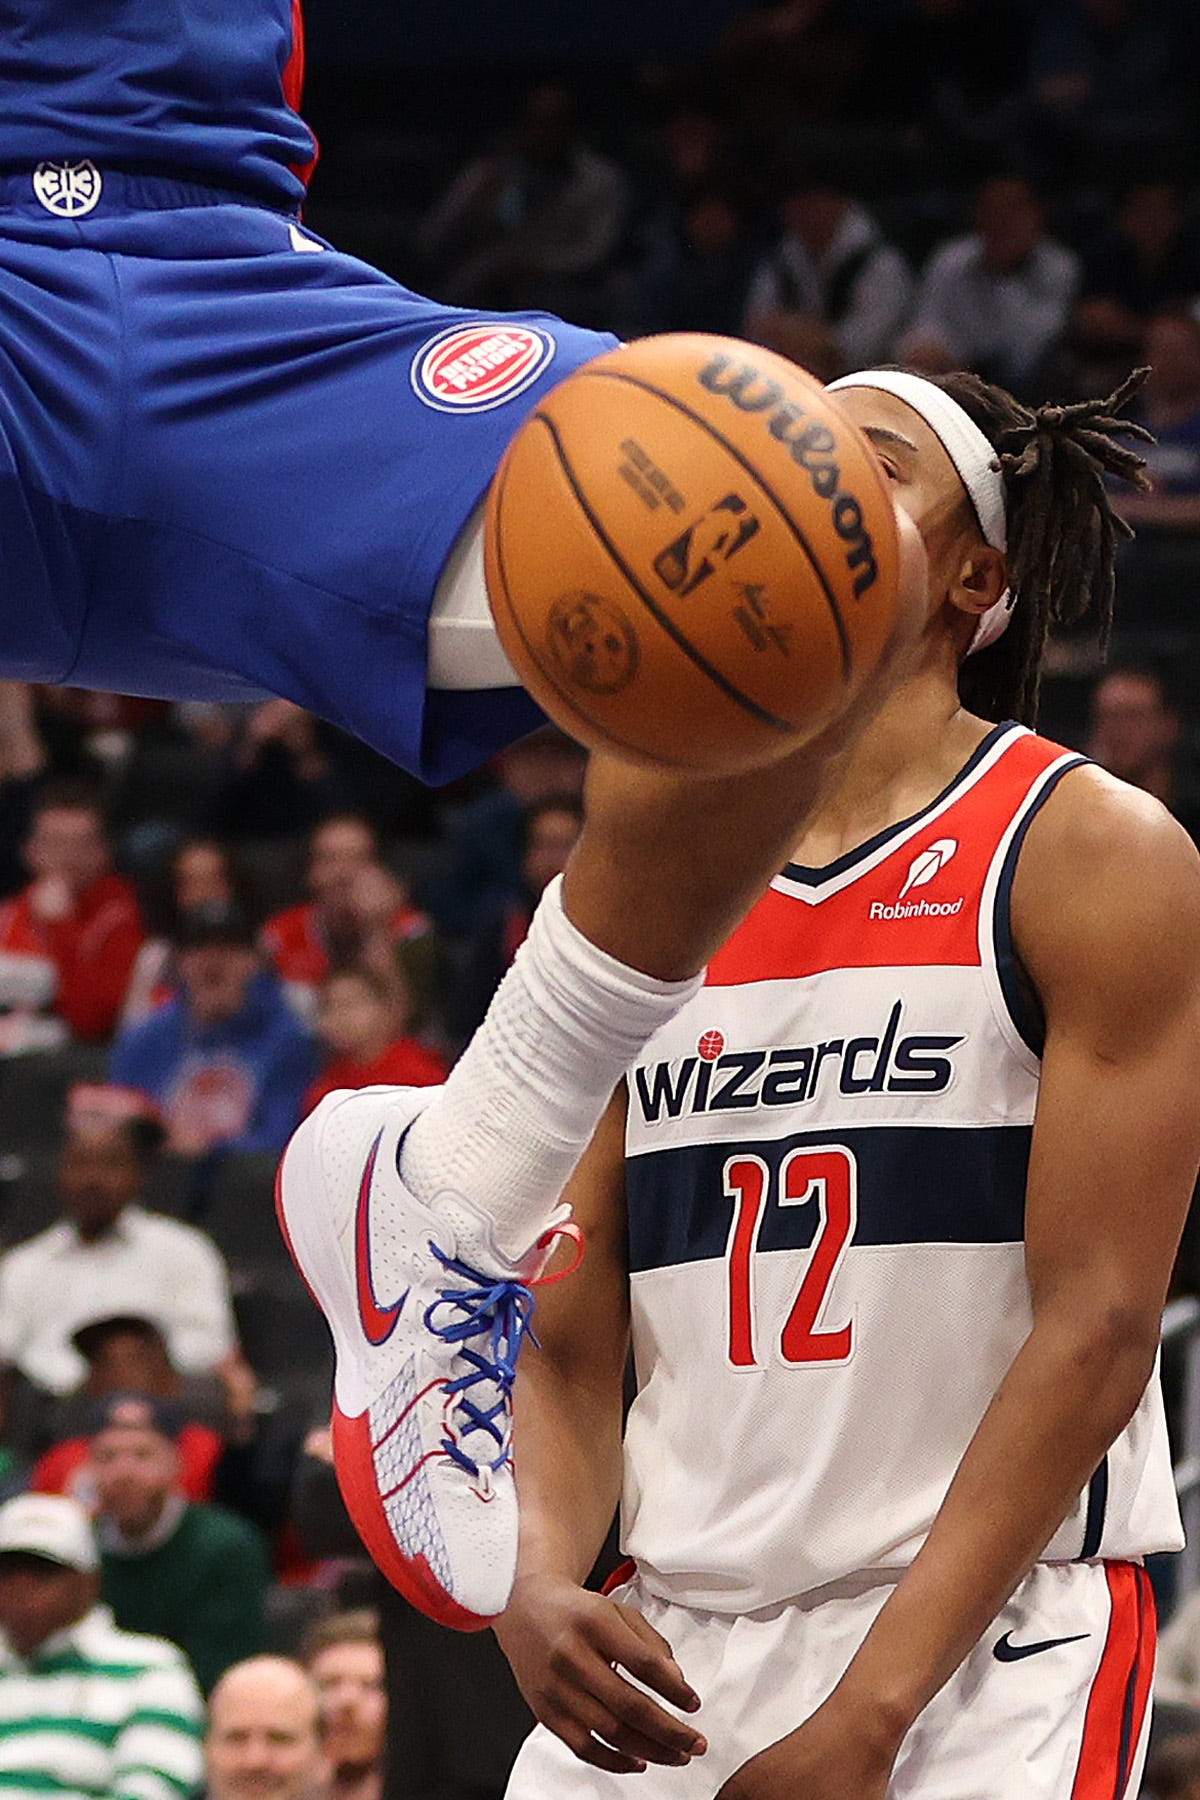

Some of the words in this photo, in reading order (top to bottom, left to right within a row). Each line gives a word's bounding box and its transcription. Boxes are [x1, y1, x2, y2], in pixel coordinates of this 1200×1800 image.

[437, 334, 512, 380] DETROIT
[450, 340, 527, 390] PISTONS
[698, 353, 879, 600] Wilson
[869, 897, 964, 920] Robinhood
[723, 1144, 858, 1372] 12
